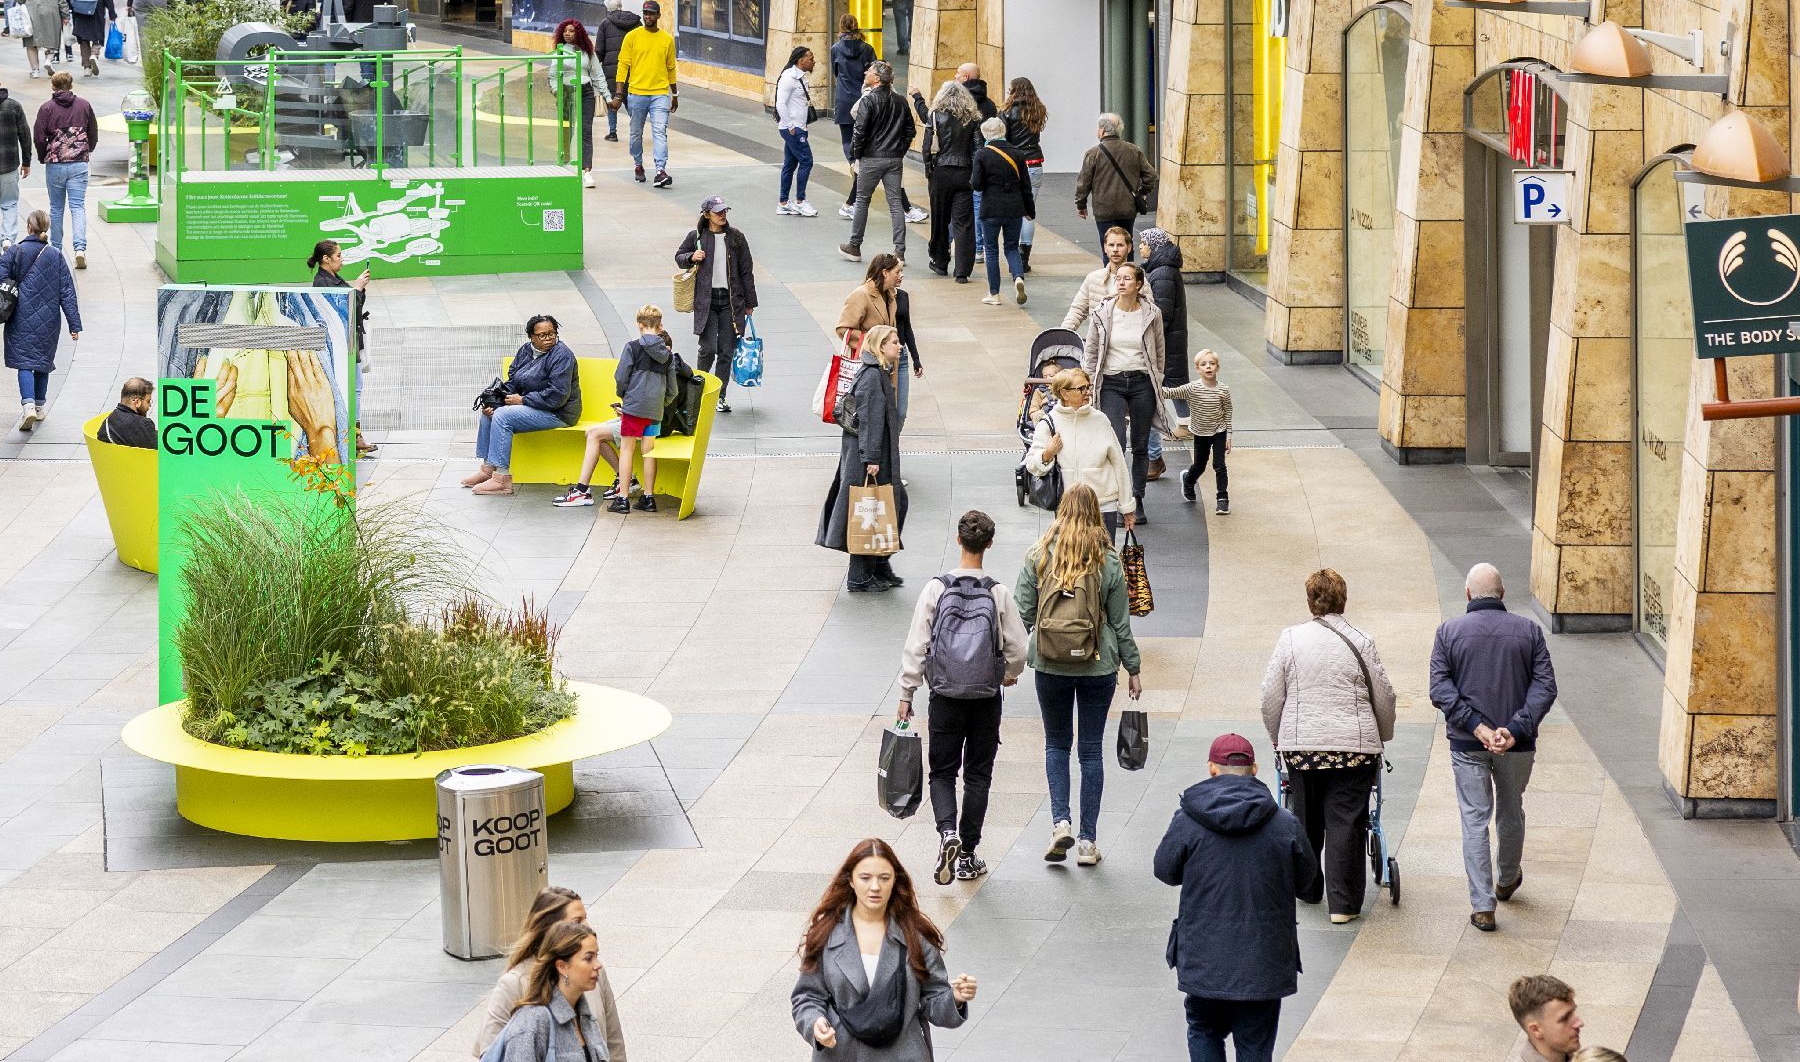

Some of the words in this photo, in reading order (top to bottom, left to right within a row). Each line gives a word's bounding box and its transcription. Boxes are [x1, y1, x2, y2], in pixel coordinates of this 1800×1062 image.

[1522, 183, 1545, 219] P
[1704, 332, 1736, 347] THE
[1740, 329, 1782, 344] BODY
[1786, 329, 1800, 342] S
[162, 384, 210, 419] DE
[162, 422, 286, 458] GOOT
[437, 812, 451, 834] OP
[472, 808, 540, 837] KOOP
[473, 827, 541, 857] GOOT
